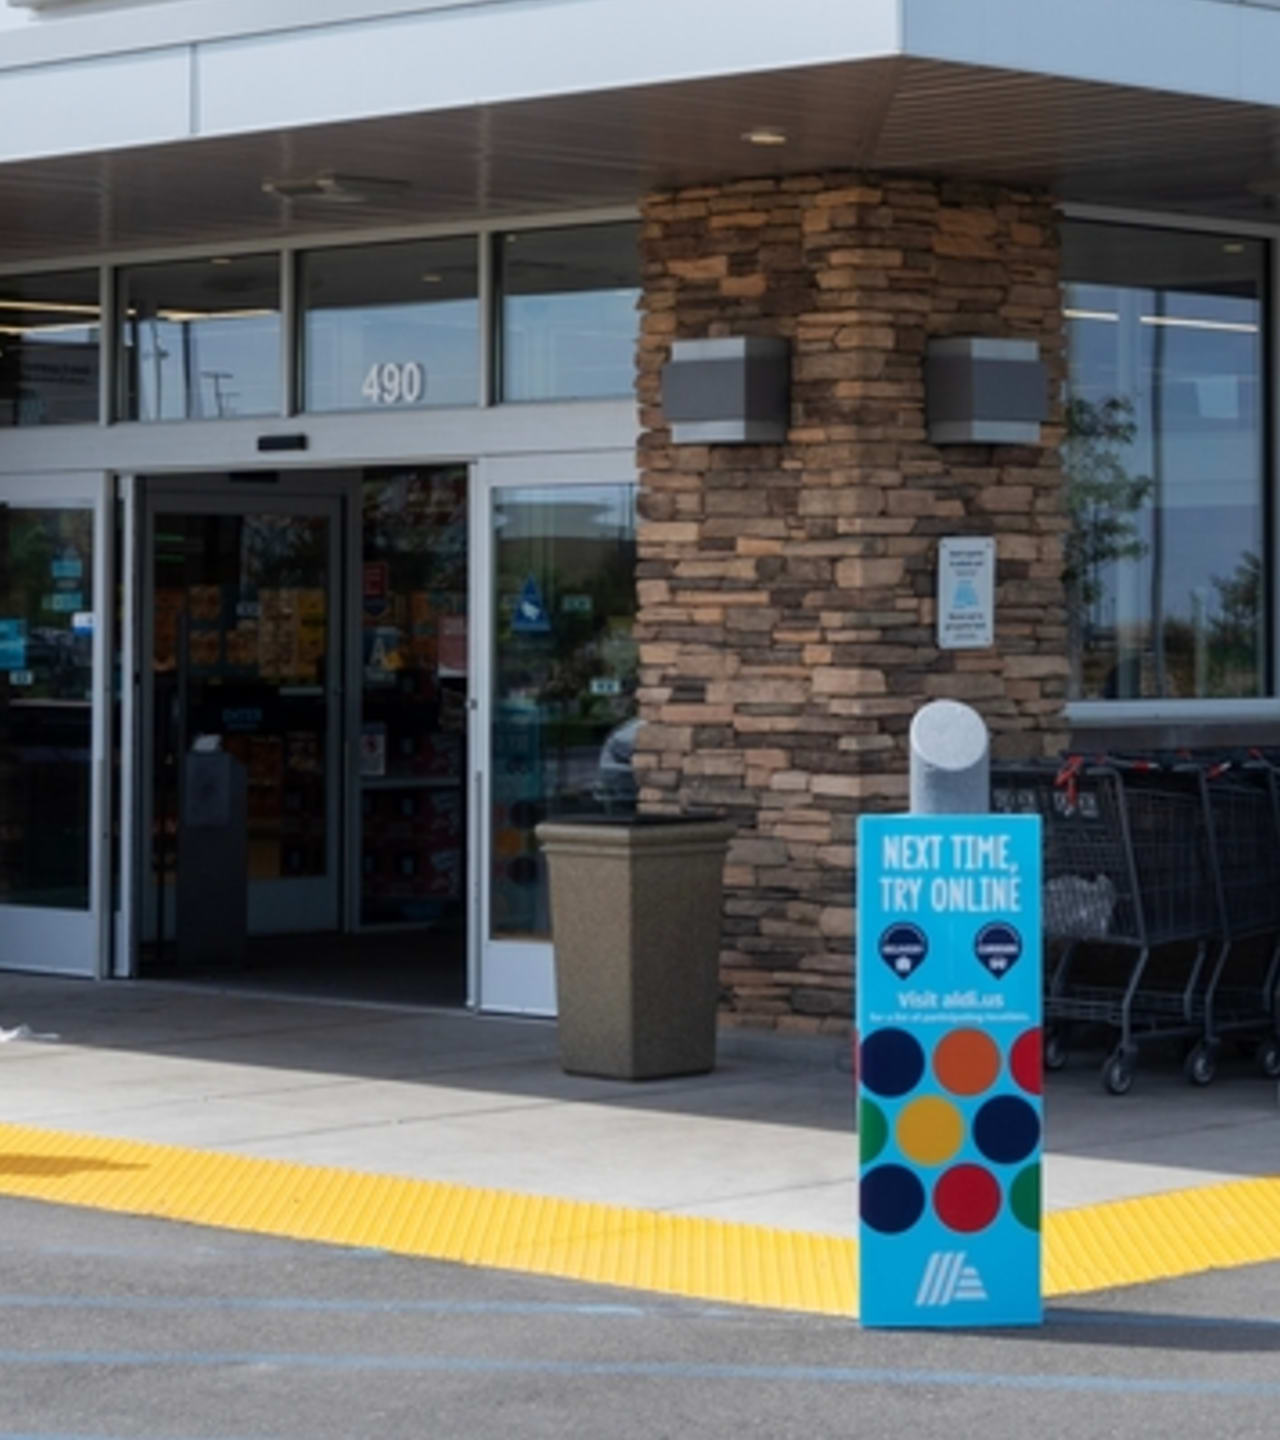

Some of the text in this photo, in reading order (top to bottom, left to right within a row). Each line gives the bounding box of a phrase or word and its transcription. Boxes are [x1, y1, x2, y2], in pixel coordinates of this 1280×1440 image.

[362, 362, 421, 404] 490
[882, 835, 1019, 875] NEXT TIME,
[880, 876, 1022, 913] TRY ONLINE
[897, 990, 1005, 1009] Visit aldi.us
